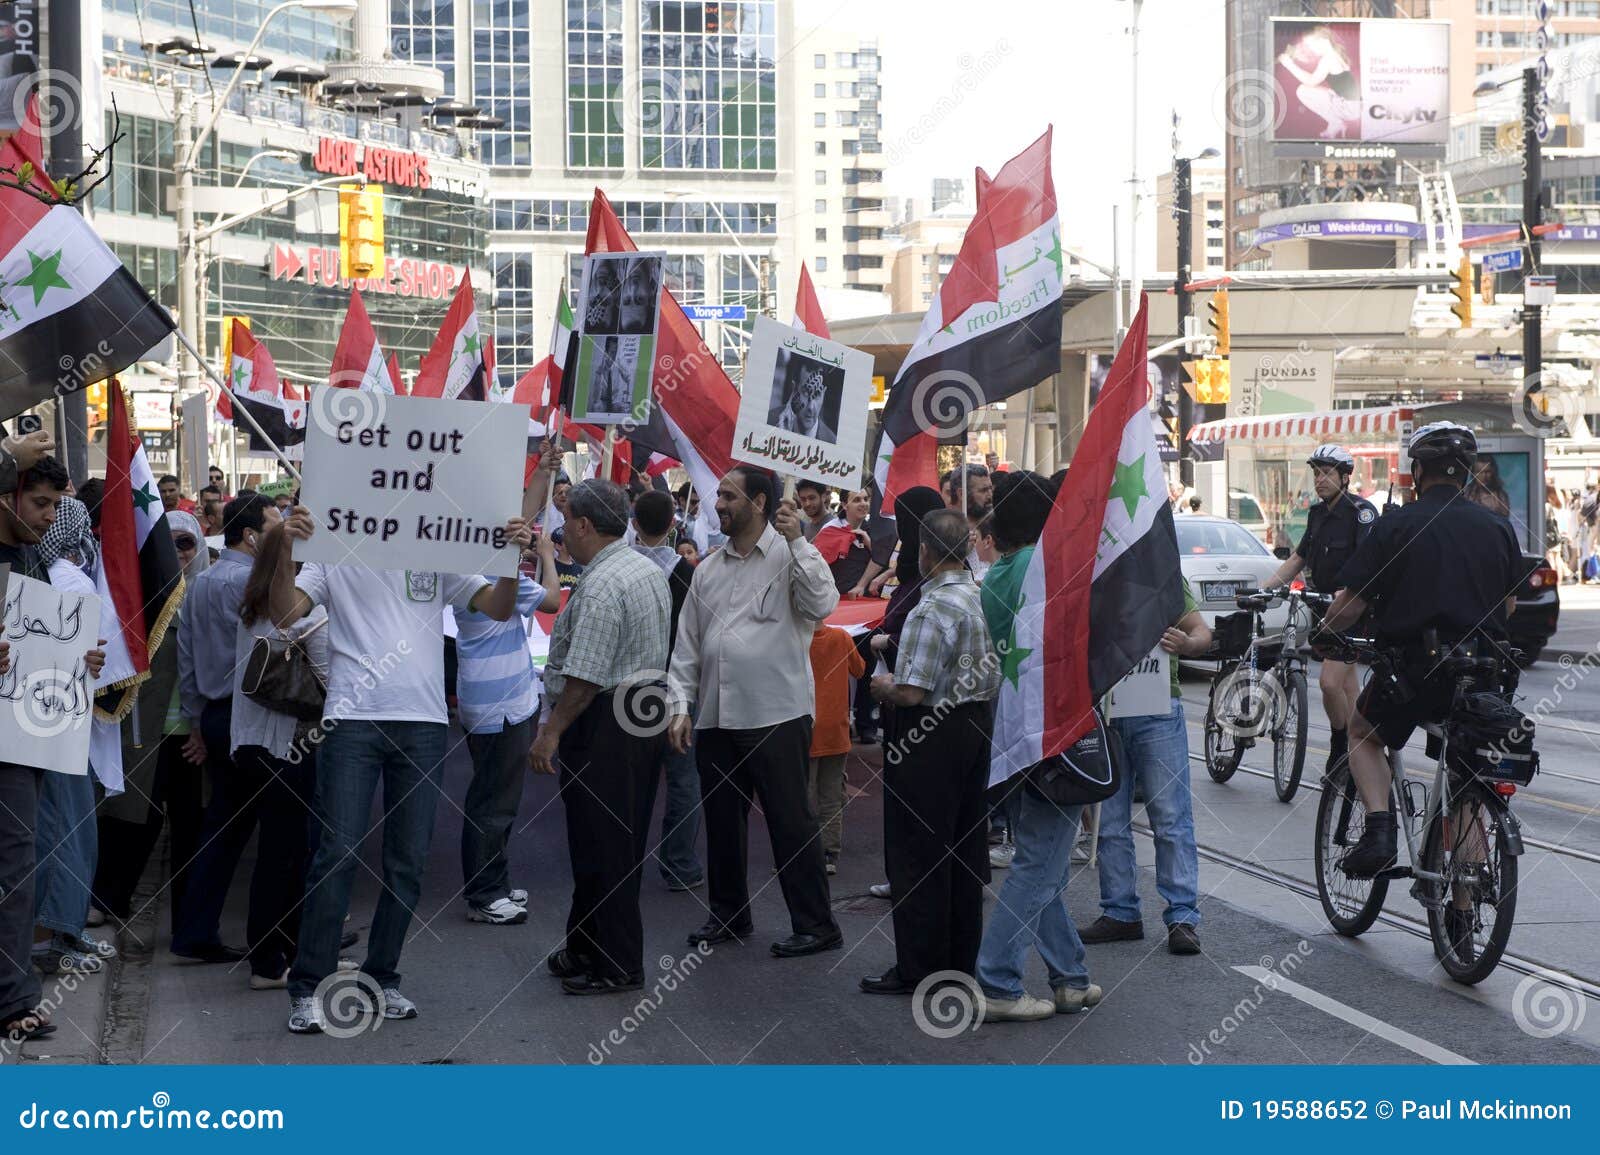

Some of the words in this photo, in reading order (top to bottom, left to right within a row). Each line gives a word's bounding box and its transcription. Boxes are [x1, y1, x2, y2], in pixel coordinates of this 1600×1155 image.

[15, 0, 33, 55] HOT
[1369, 104, 1437, 124] Citytv
[314, 136, 358, 177] JACK
[363, 145, 431, 189] ASTOR'S
[1325, 145, 1396, 158] Panasonic
[1328, 222, 1382, 234] Weekdays
[307, 247, 396, 293] FUE
[401, 257, 456, 300] SHOP
[693, 306, 724, 320] Yonge
[1261, 368, 1316, 377] DUNDAS
[1242, 387, 1251, 415] NGE
[337, 421, 391, 448] Get
[407, 429, 464, 455] out
[371, 462, 434, 493] and
[327, 508, 399, 542] Stop
[416, 515, 509, 549] killing
